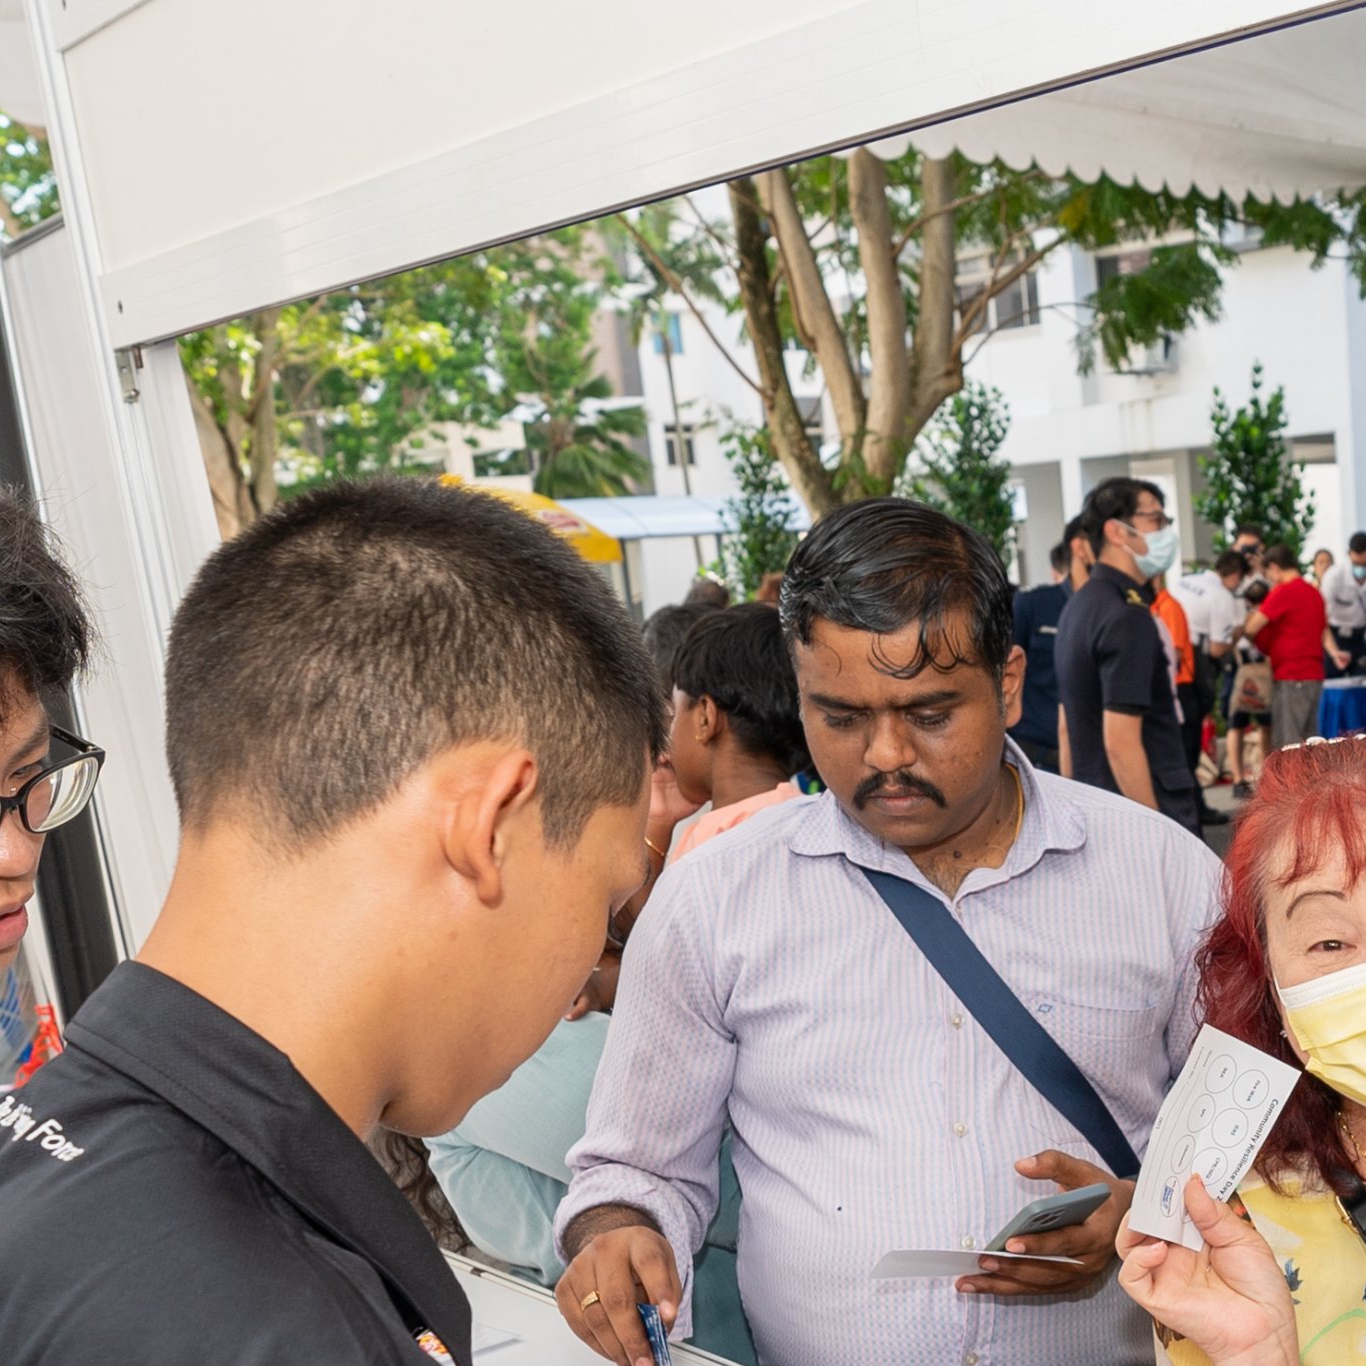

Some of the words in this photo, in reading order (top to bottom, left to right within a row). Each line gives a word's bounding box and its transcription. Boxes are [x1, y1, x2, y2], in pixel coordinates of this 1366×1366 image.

[1252, 1098, 1279, 1143] Community
[1231, 1143, 1256, 1178] Resilience
[1218, 1179, 1233, 1196] Day
